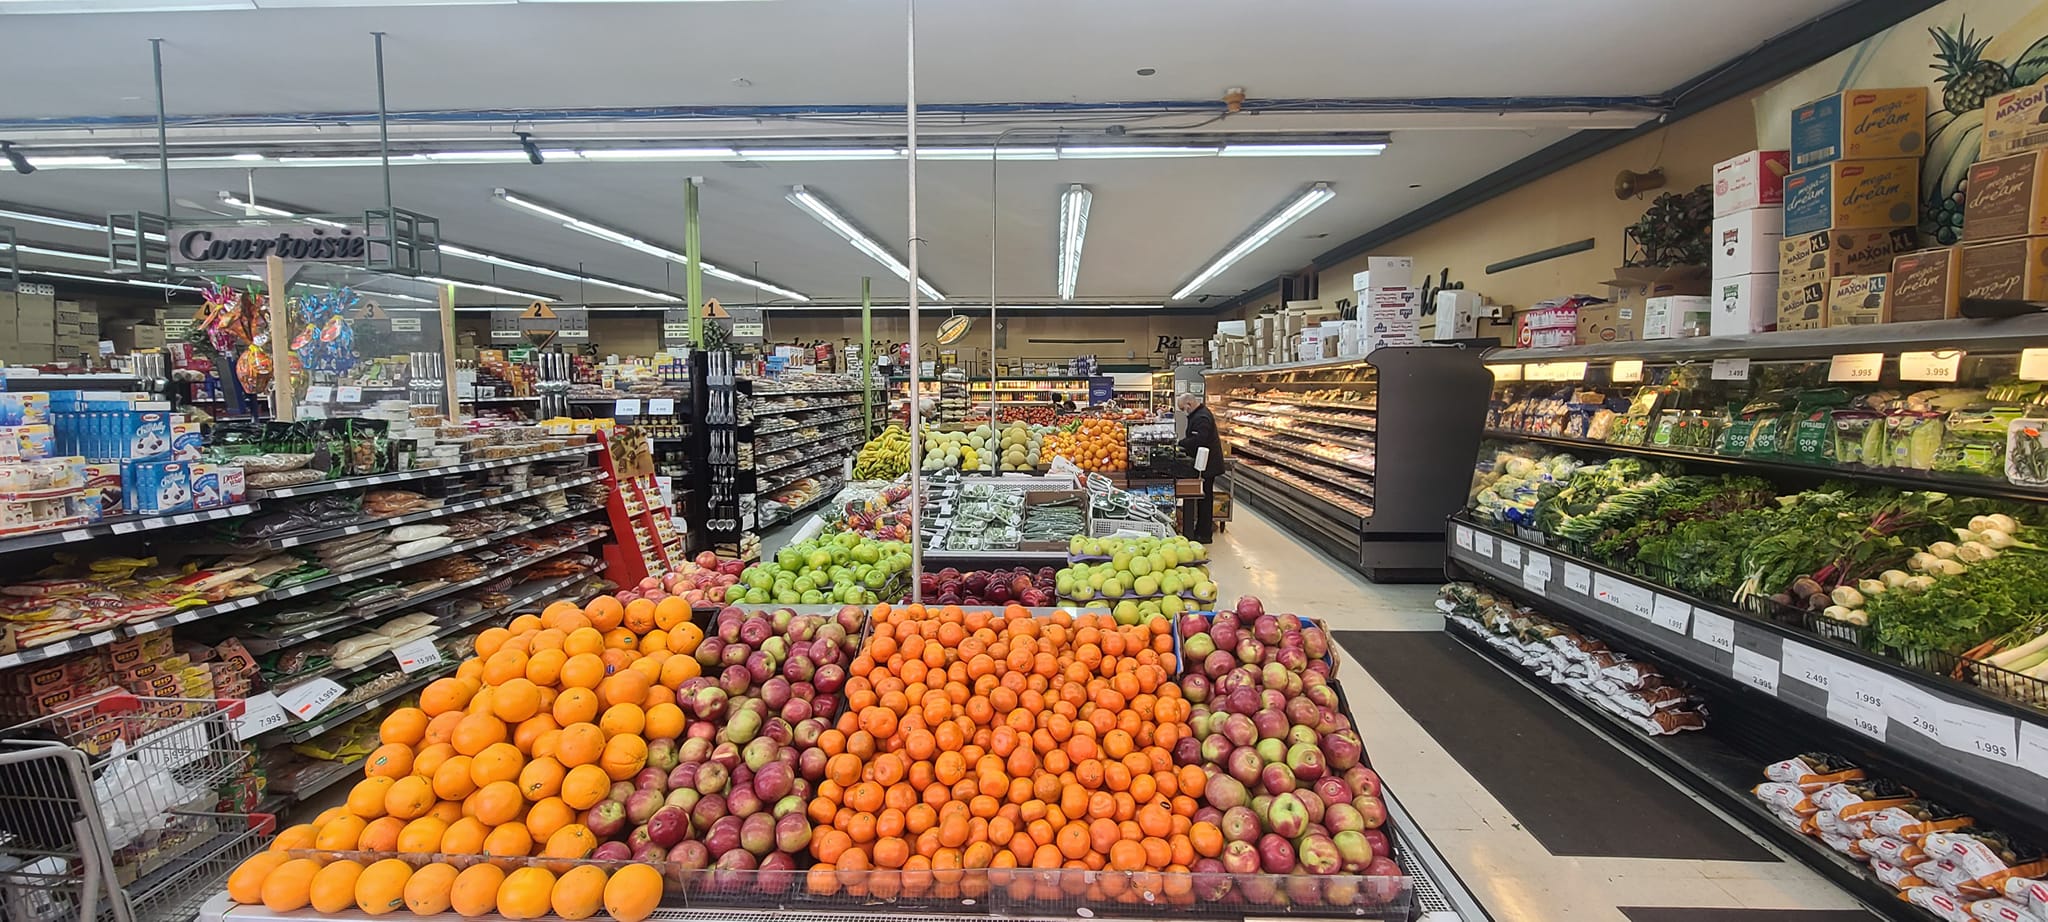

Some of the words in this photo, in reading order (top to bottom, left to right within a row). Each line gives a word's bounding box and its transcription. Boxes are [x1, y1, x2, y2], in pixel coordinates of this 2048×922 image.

[1996, 91, 2043, 120] MAXON
[1854, 112, 1910, 135] dream
[1787, 187, 1825, 211] dream
[1842, 184, 1900, 206] dream
[1969, 181, 2024, 209] dream
[179, 229, 365, 262] Courtoisie
[1787, 249, 1810, 265] MAXON
[1811, 236, 1826, 251] XL
[1847, 245, 1891, 265] MAXON
[1892, 235, 1913, 250] XL
[1837, 281, 1868, 298] MAXON
[1869, 278, 1884, 292] XL
[1894, 276, 1940, 297] dream
[1784, 299, 1804, 312] MAXON
[1804, 287, 1818, 301] XL
[366, 303, 374, 318] 3
[534, 303, 542, 317] 2
[707, 302, 716, 316] 1
[1851, 368, 1872, 377] 3.99$
[1926, 367, 1949, 377] 3.99$
[1635, 604, 1649, 615] 2.49$
[1668, 618, 1682, 630] 1.99$
[1712, 635, 1729, 647] 3.49$
[118, 651, 137, 662] RIO
[416, 653, 437, 665] 15.99$
[37, 671, 61, 683] RIO
[137, 666, 154, 677] RIO
[1806, 671, 1828, 686] 2.49$
[153, 676, 172, 686] RIO
[1752, 676, 1773, 690] 2.99$
[43, 692, 68, 705] RIO
[156, 686, 175, 696] RIO
[314, 687, 338, 706] 14.99$
[1855, 691, 1882, 707] 1.99$
[259, 713, 282, 728] 7.99$
[1854, 718, 1879, 734] 1.99$
[1975, 740, 2007, 757] 1.99$
